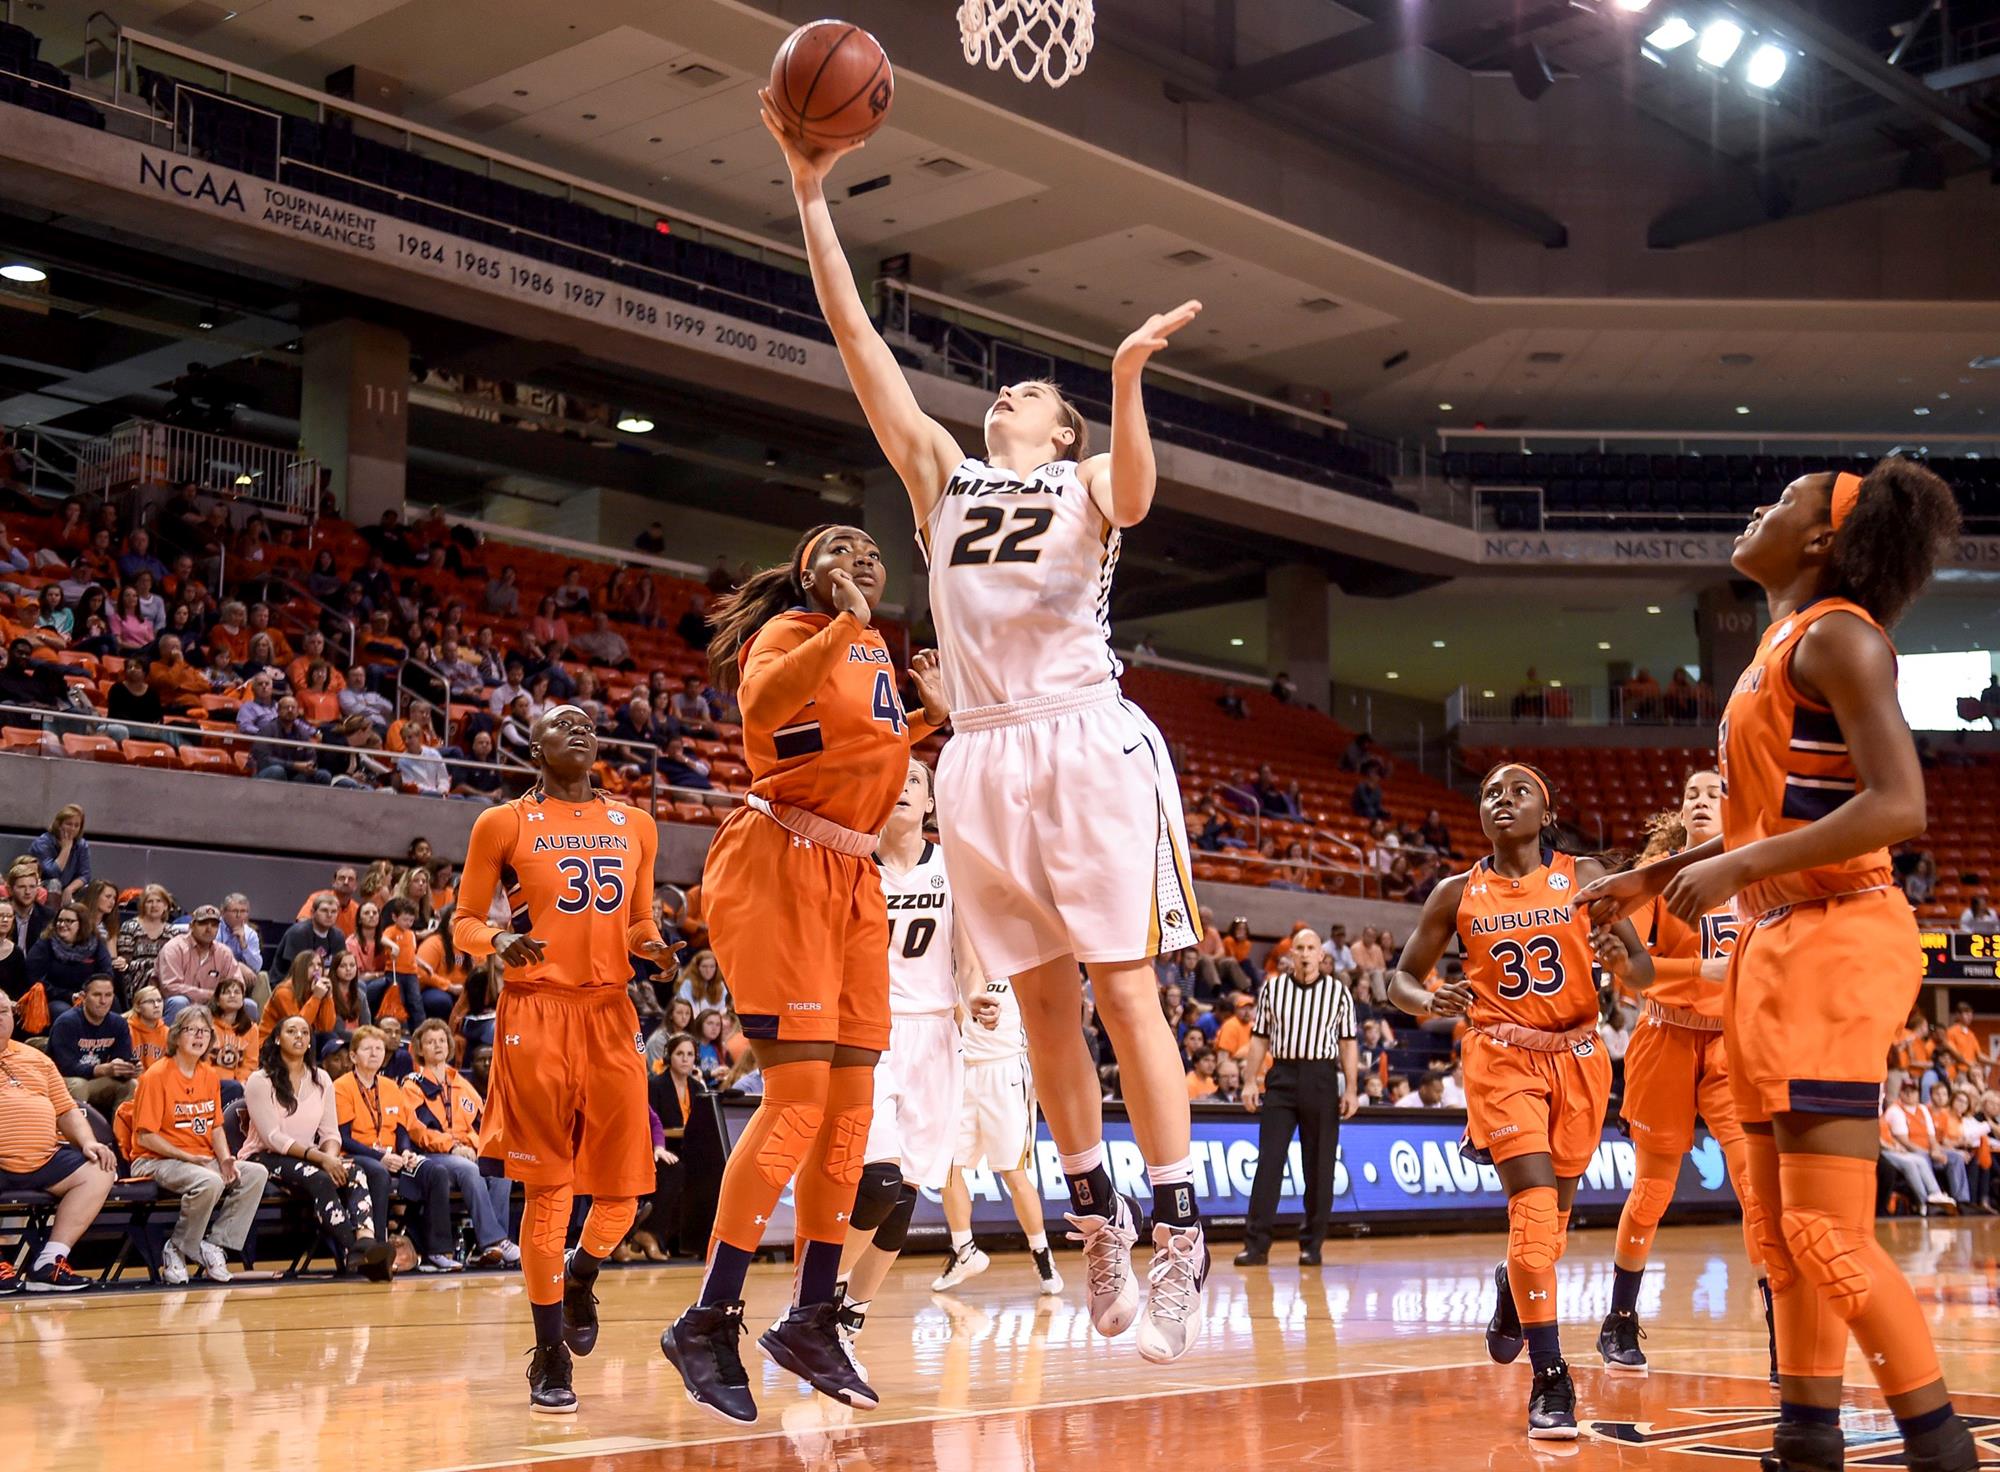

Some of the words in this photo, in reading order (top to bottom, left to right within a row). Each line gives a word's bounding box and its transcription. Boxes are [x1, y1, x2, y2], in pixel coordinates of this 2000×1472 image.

[139, 152, 246, 213] NCAA
[261, 206, 376, 252] APPEARANCES
[263, 187, 377, 234] TOURNAMENT
[397, 233, 445, 264] 1984
[455, 250, 501, 280] 1985
[509, 265, 555, 296] 1986
[563, 281, 606, 308] 1987
[615, 296, 657, 325] 1988
[665, 311, 706, 337] 1999
[715, 325, 757, 352] 2000
[766, 340, 808, 366] 2003
[948, 505, 1055, 569] 22
[1485, 539, 1551, 557] NCAA
[1717, 613, 1752, 633] 109
[532, 835, 629, 853] AUBURN
[555, 856, 625, 914] 35
[886, 893, 946, 910] ZZOU
[1471, 906, 1572, 936] AUBURN
[1700, 912, 1741, 960] 15
[1489, 934, 1566, 1000] 33
[1963, 965, 1993, 976] PERIOD
[787, 1002, 822, 1011] TIGERS
[1489, 1124, 1519, 1140] TIGERS
